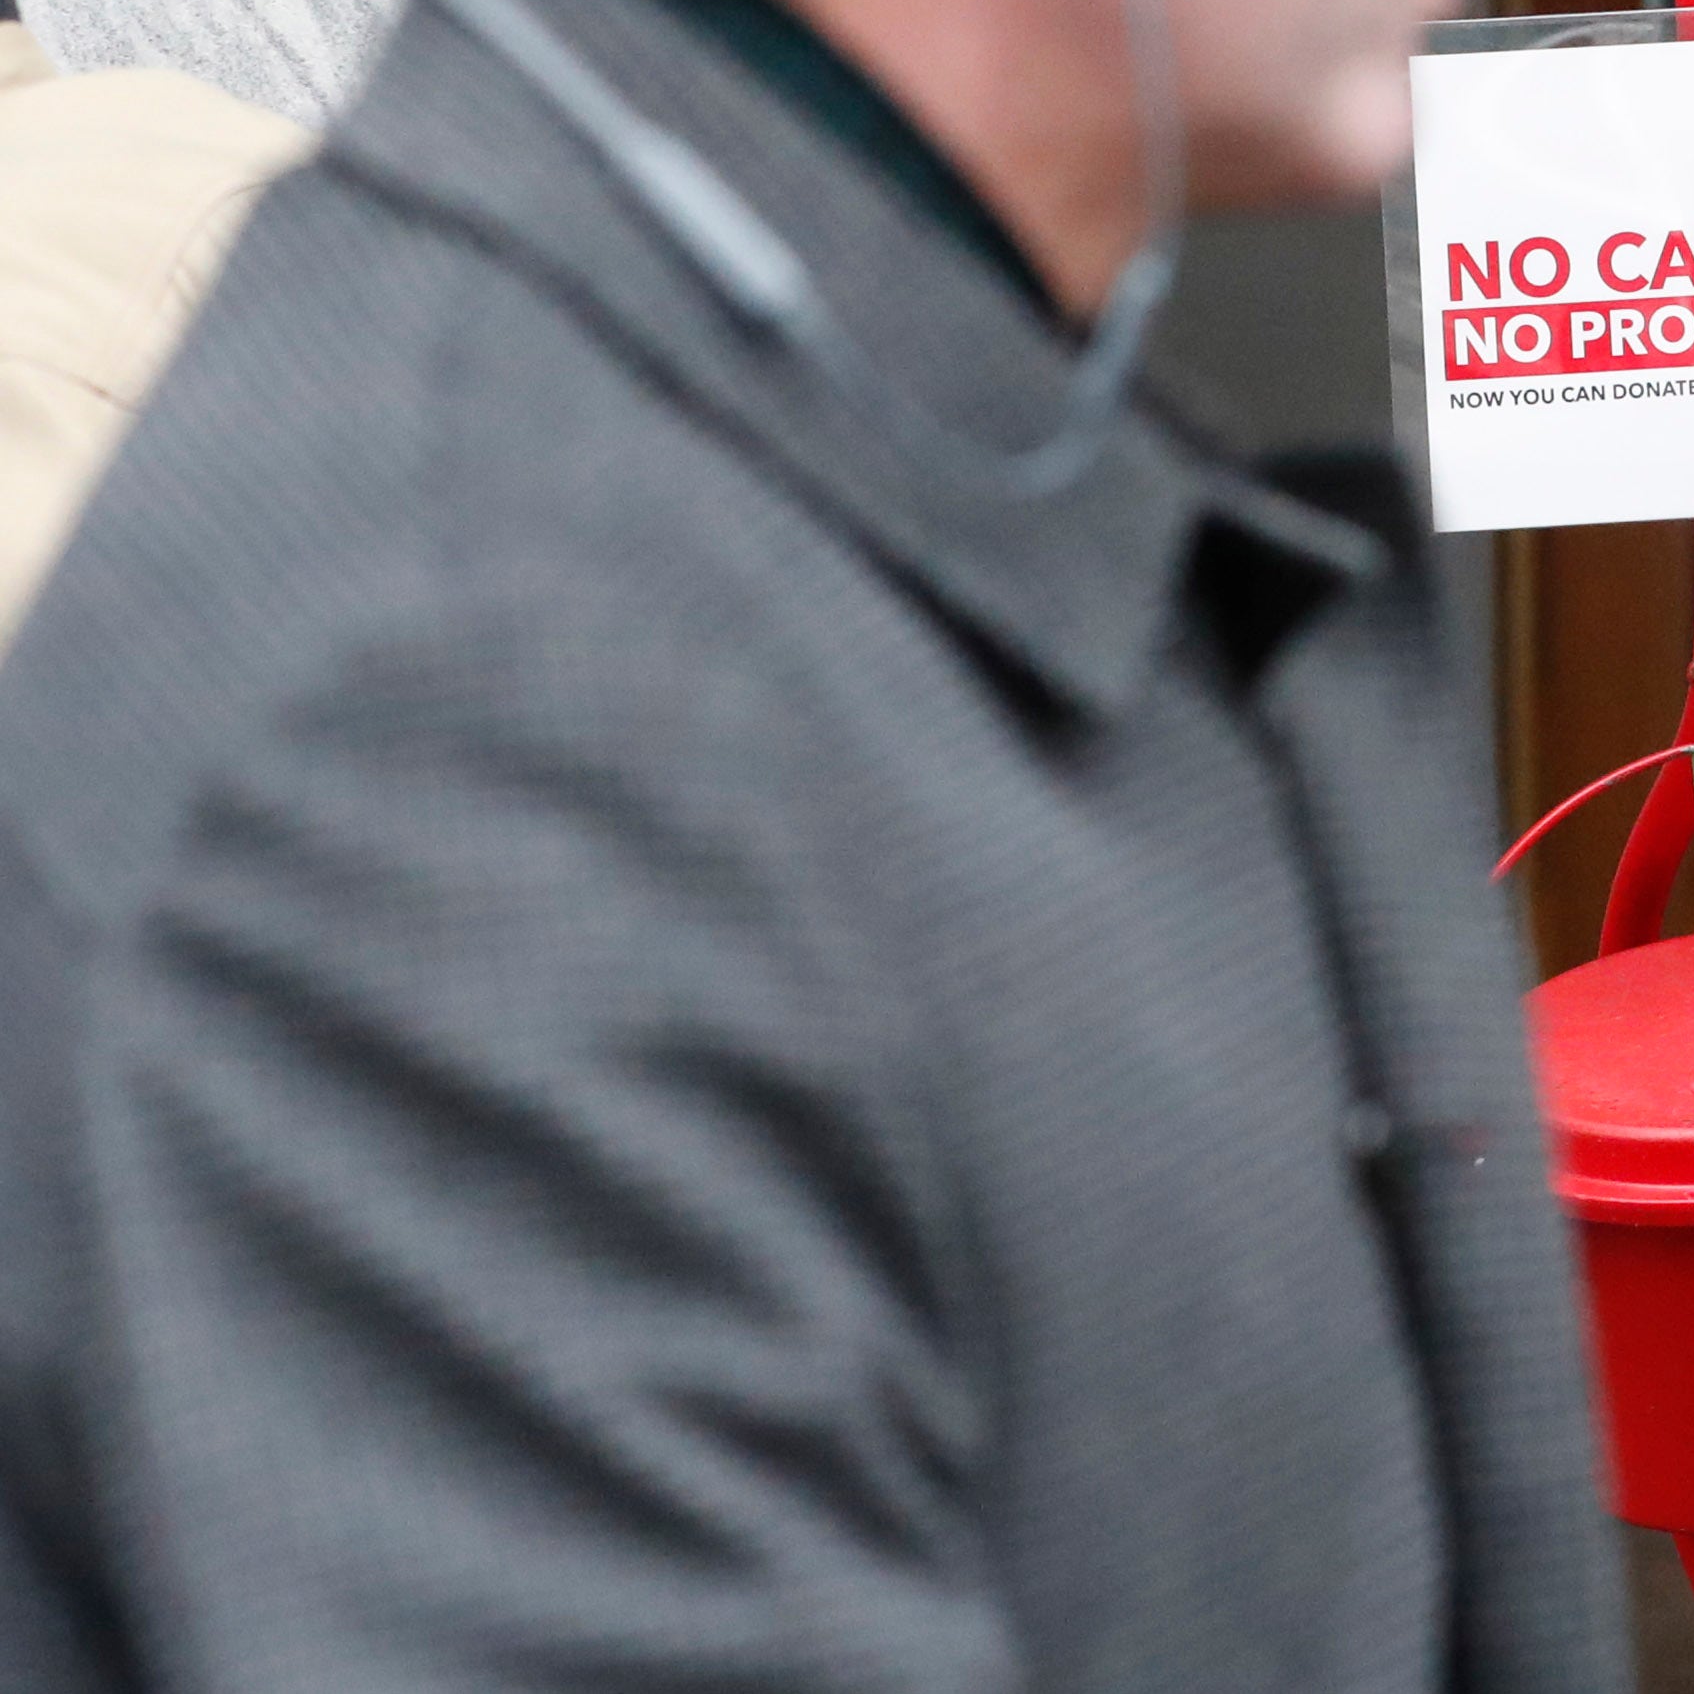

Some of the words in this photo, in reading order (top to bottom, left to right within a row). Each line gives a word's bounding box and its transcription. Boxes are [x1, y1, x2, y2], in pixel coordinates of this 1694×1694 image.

[1447, 236, 1571, 302] NO
[1453, 313, 1552, 366] NO
[1450, 391, 1504, 409] NOW
[1509, 388, 1555, 406] YOU
[1561, 385, 1605, 403] CAN
